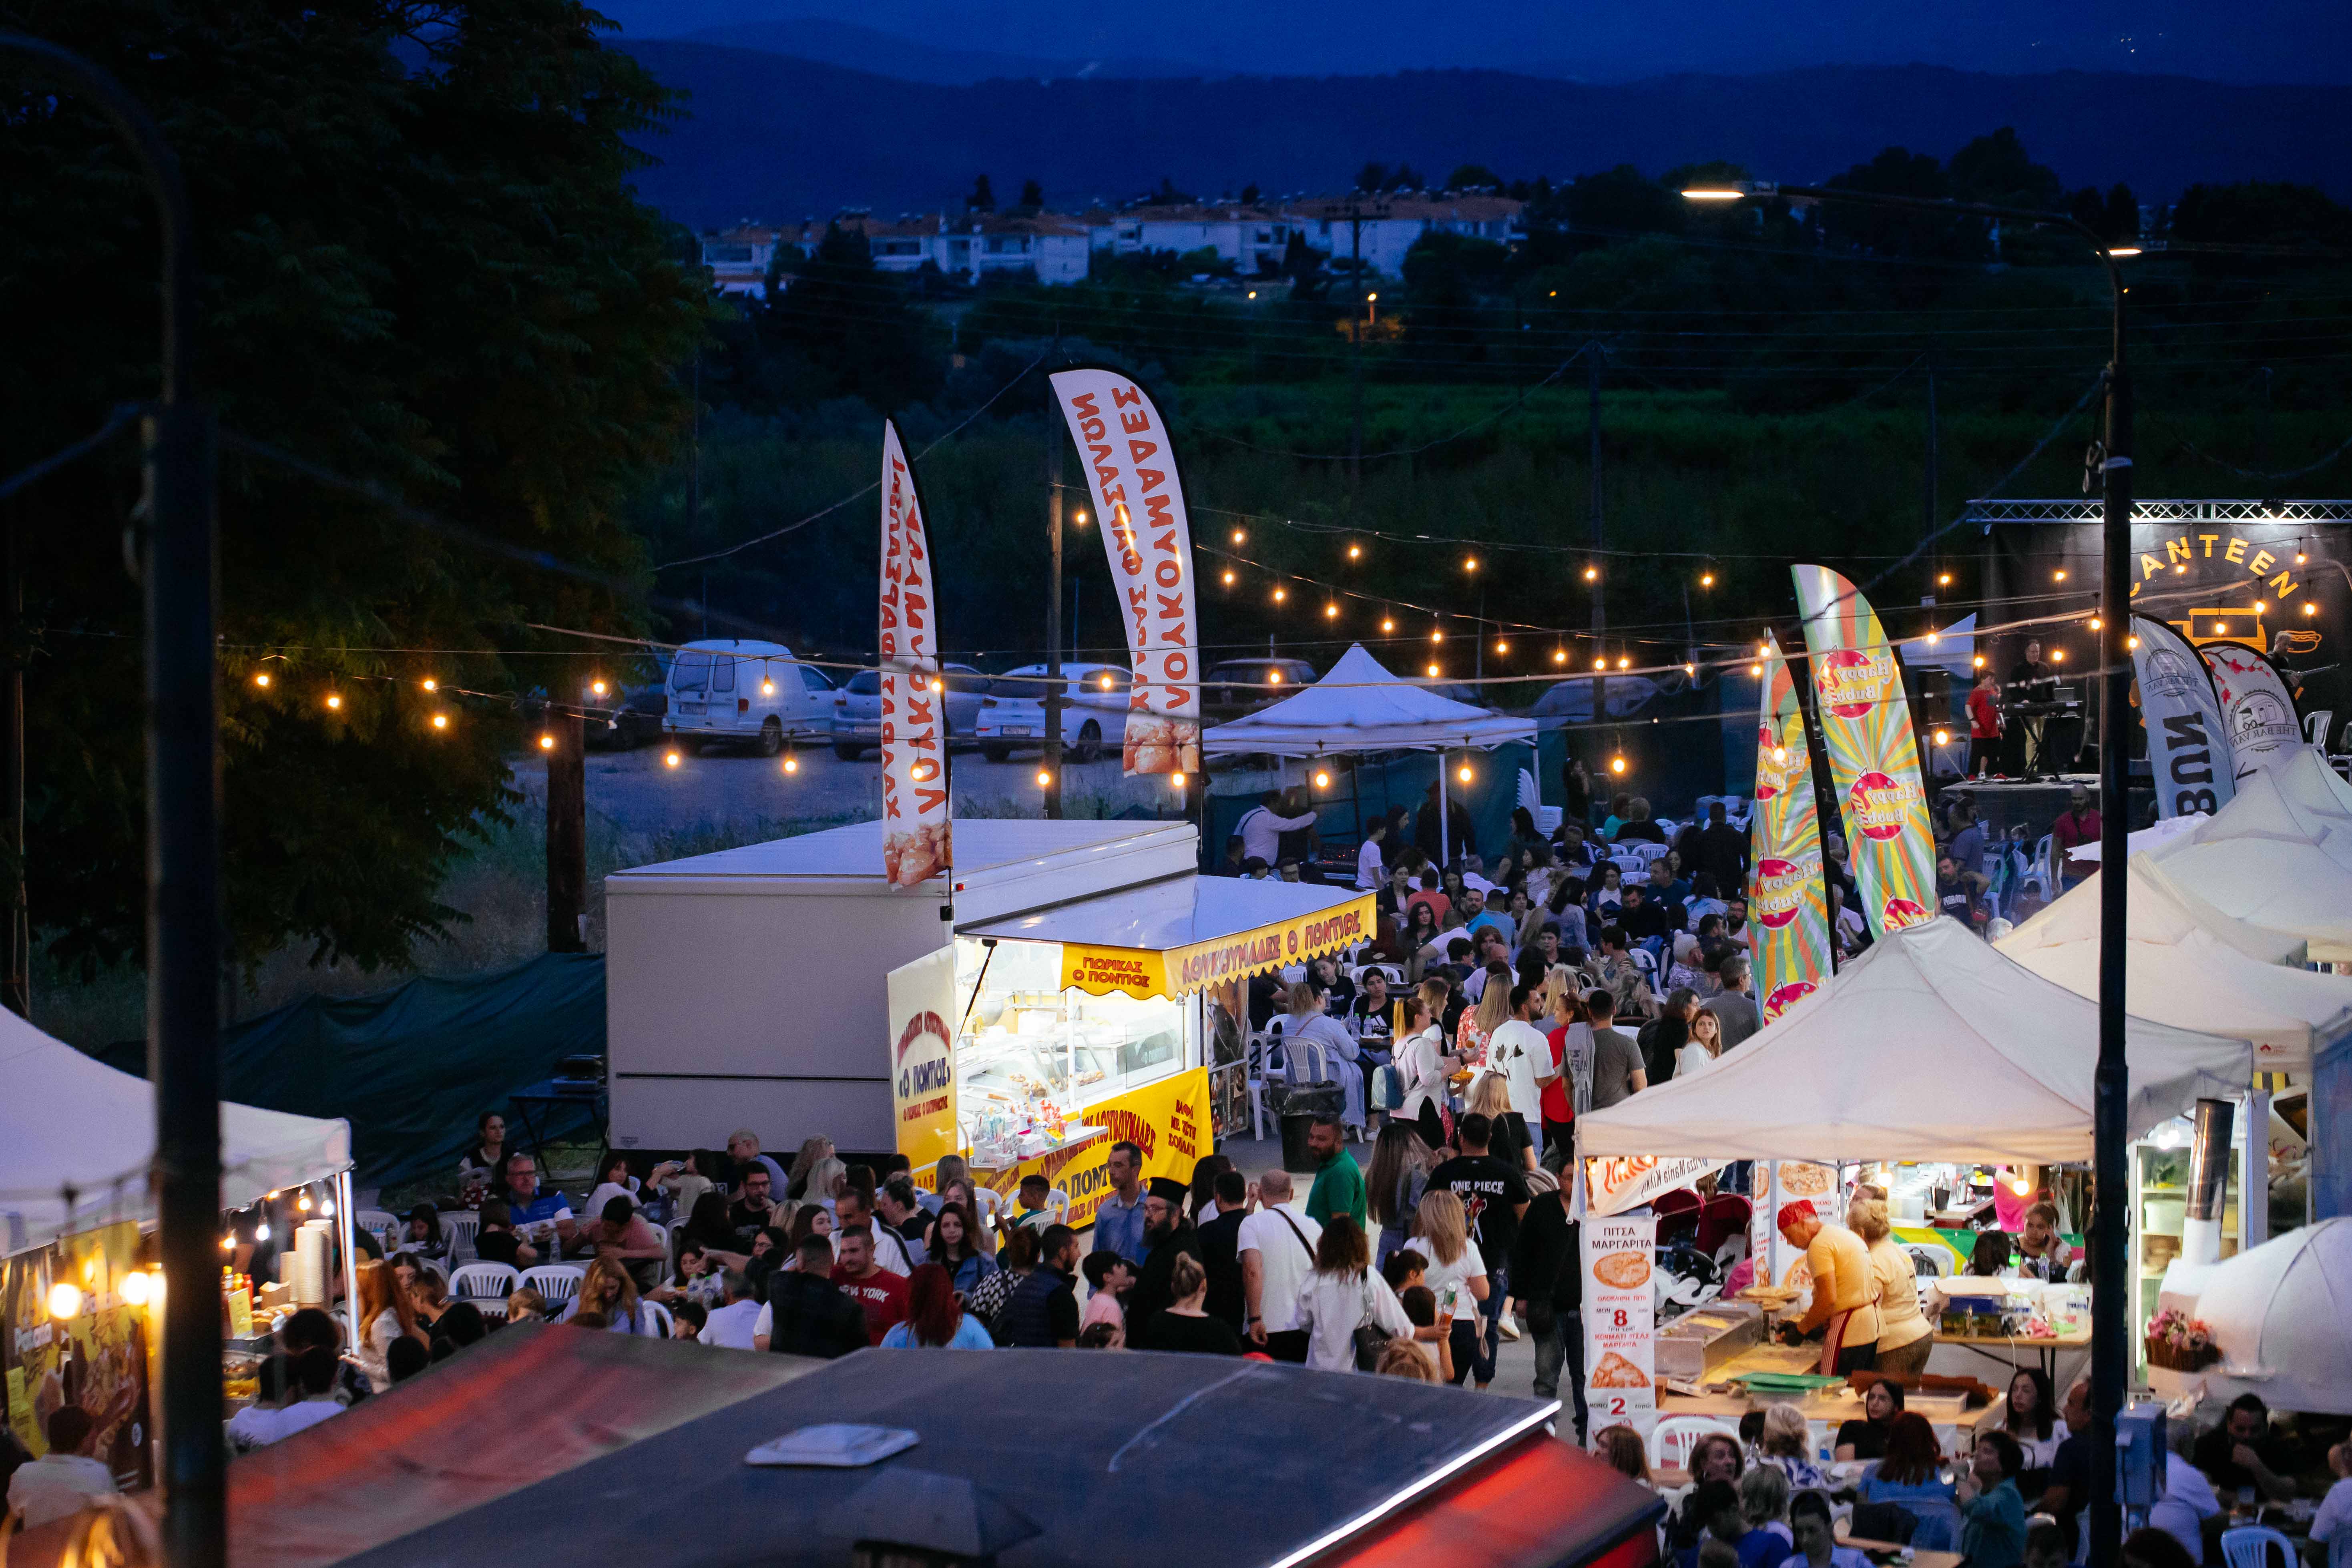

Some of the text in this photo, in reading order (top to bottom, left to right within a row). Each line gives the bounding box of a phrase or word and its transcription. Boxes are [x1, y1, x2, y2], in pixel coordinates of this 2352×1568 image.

[2130, 534, 2299, 599] ANTEEN
[1182, 909, 1361, 984] ΛΟΥΚΟΥΜΑΔΕΣ Ο ΠΟΝΤΙΟΣ
[1083, 957, 1143, 973] ΓΙΩΡΙΚΑΣ
[1073, 970, 1150, 987] Ο ΠΟΝΤΙΟΣ
[1071, 1162, 1109, 1200] ΠΟΝΤ
[1451, 1181, 1504, 1195] ONE PIECE
[1604, 1227, 1635, 1237] ΠΙΤΣΑ
[1592, 1239, 1652, 1249] ΜΑΡΓΑΡΙΤΑ
[863, 1287, 890, 1303] YORK
[1614, 1309, 1628, 1326] 8
[1611, 1397, 1626, 1415] 2
